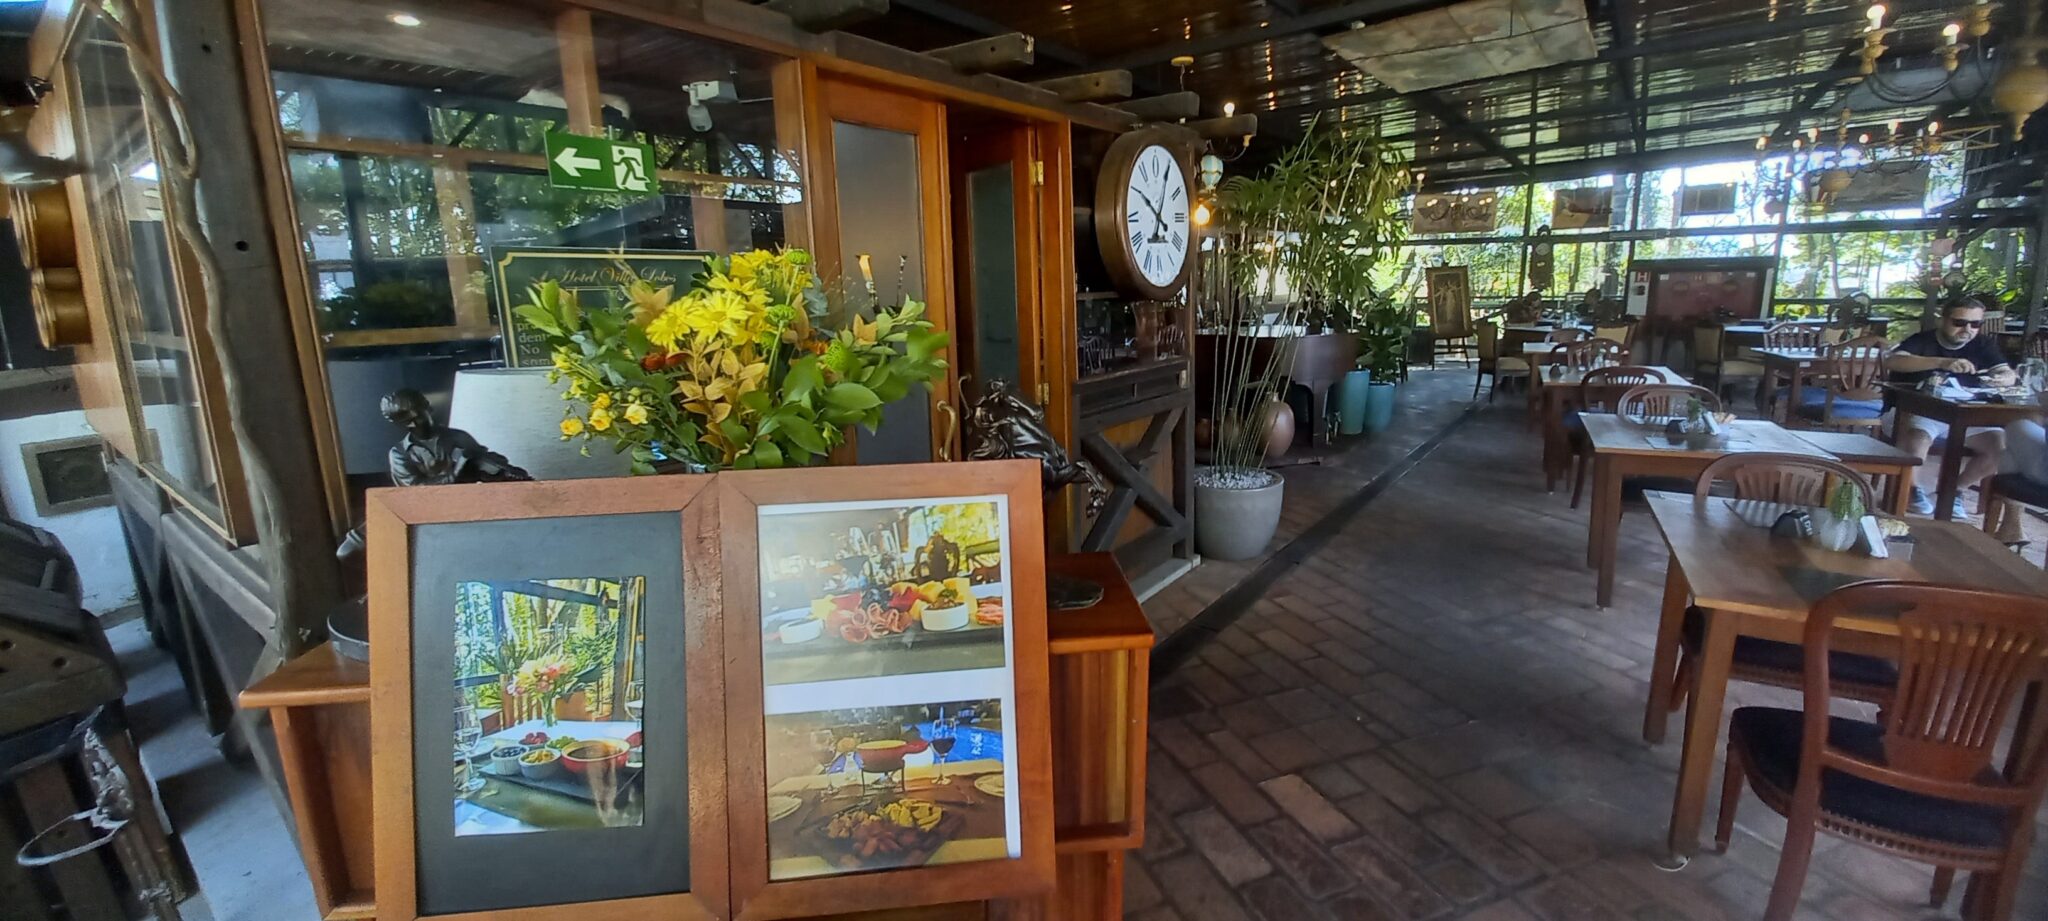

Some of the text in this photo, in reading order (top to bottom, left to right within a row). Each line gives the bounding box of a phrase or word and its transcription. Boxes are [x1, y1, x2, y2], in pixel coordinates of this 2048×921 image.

[1174, 212, 1185, 223] III
[560, 267, 598, 283] Hotel
[520, 345, 541, 356] No
